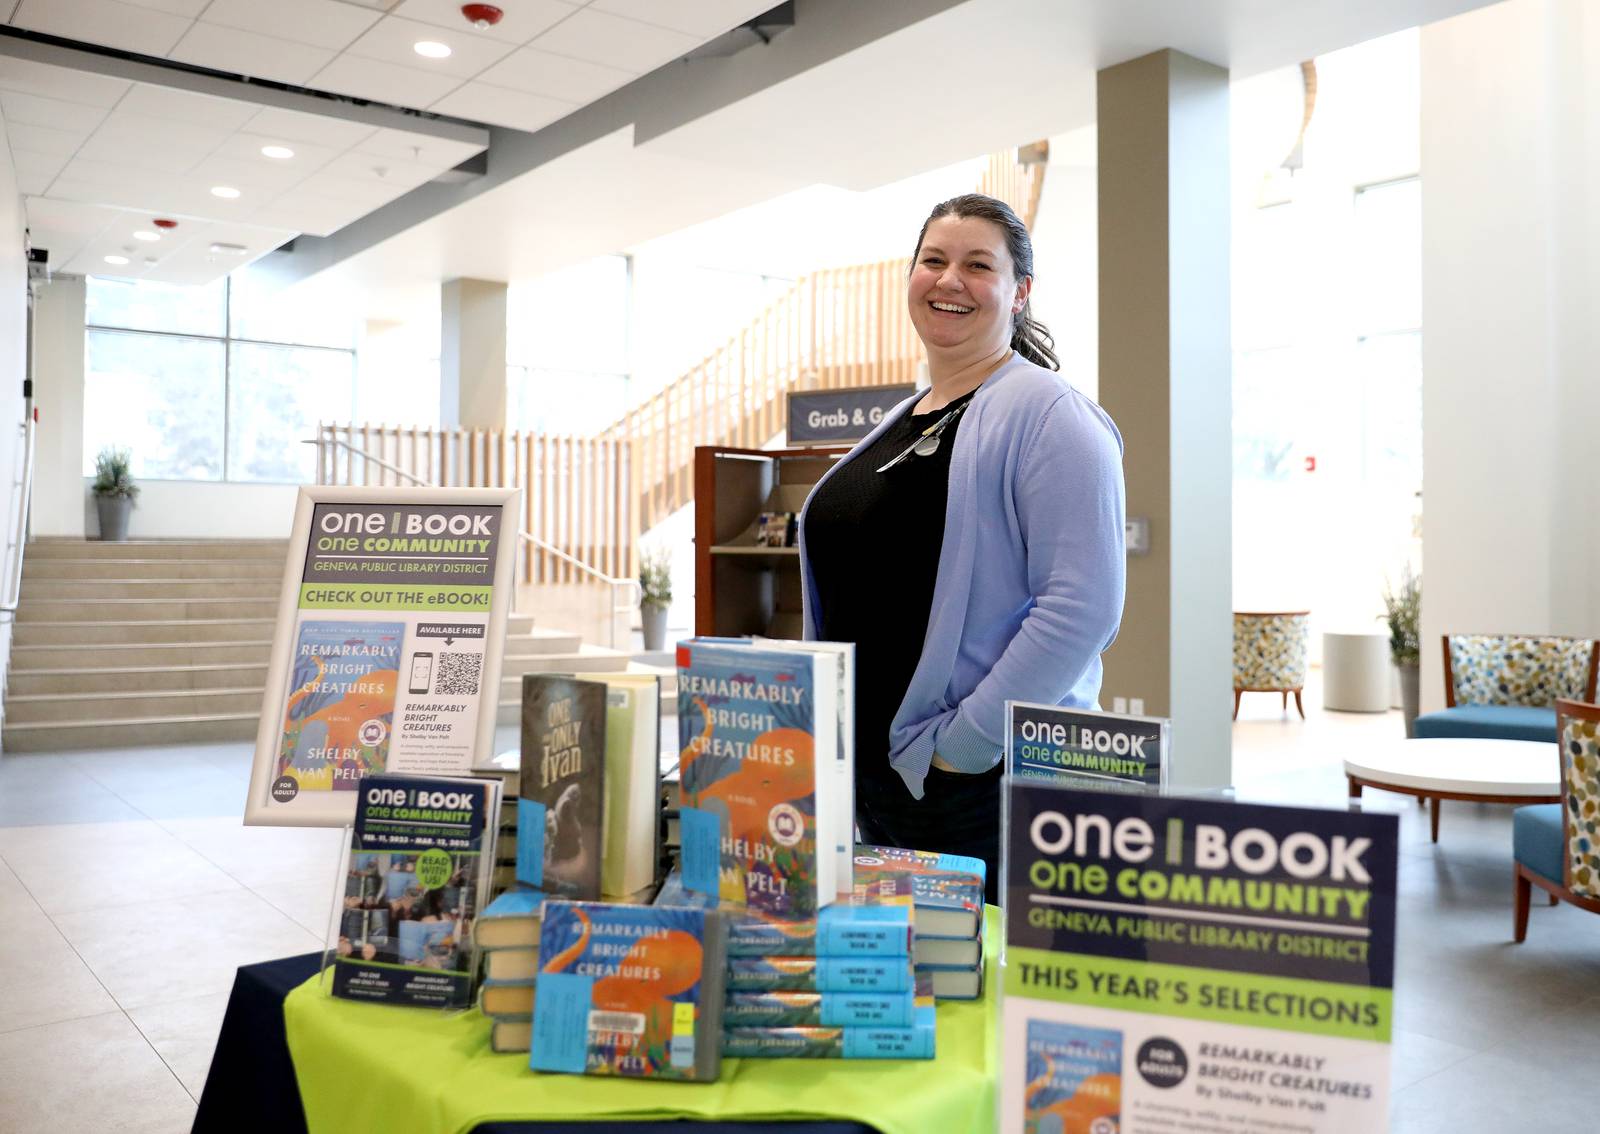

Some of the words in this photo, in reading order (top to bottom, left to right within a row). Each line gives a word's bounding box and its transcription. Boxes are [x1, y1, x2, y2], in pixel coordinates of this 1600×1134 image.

[808, 407, 849, 428] Grab
[852, 408, 866, 426] &
[321, 512, 386, 534] one
[406, 514, 494, 536] BOOK
[317, 536, 359, 551] one
[363, 537, 491, 554] COMMUNITY
[314, 562, 358, 572] GENEVA
[360, 562, 396, 572] PUBLIC
[399, 563, 440, 573] LIBRARY
[443, 563, 488, 574] DISTRICT
[306, 590, 356, 603] CHECK
[360, 591, 393, 604] OUT
[397, 591, 425, 604] THE
[427, 593, 489, 605] eBOOK!
[419, 626, 461, 635] AVAILABLE
[462, 627, 482, 635] HERE
[301, 644, 397, 657] REMARKABLY
[320, 663, 373, 675] BRIGHT
[303, 682, 385, 694] CREATURES
[679, 674, 805, 705] REMARKABLY
[405, 703, 467, 712] REMARKABLY
[404, 714, 438, 722] BRIGHT
[708, 707, 775, 733] BRIGHT
[402, 723, 453, 732] CREATURES
[1021, 720, 1067, 746] one
[1081, 728, 1146, 759] BOOK
[307, 748, 361, 760] SHELBY
[689, 736, 796, 766] CREATURES
[541, 745, 582, 789] Ivan
[1021, 745, 1050, 762] one
[1053, 750, 1146, 777] COMMUNITY
[297, 767, 327, 780] VAN
[334, 768, 365, 780] PELT
[367, 788, 407, 806] one
[417, 791, 474, 810] BOOK
[366, 806, 391, 818] one
[392, 808, 473, 822] COMMUNITY
[721, 837, 777, 863] HELBY
[1030, 810, 1155, 863] one
[1195, 823, 1373, 884] BOOK
[422, 857, 448, 866] READ
[422, 866, 448, 876] WITH
[747, 872, 788, 895] PELT
[1029, 860, 1108, 895] one
[1116, 868, 1371, 921] COMMUNITY
[572, 922, 671, 939] REMARKABLY
[1028, 908, 1113, 935] GENEVA
[1117, 914, 1184, 941] PUBLIC
[1189, 920, 1273, 951] LIBRARY
[1278, 931, 1371, 962] DISTRICT
[592, 943, 648, 958] BRIGHT
[576, 963, 662, 980] CREATURES
[1018, 963, 1080, 991] THIS
[1088, 970, 1190, 1005] YEAR'S
[1198, 984, 1381, 1028] SELECTIONS
[615, 1055, 648, 1070] PELT
[1149, 1048, 1176, 1060] FOR
[1199, 1042, 1326, 1072] REMARKABLY
[1198, 1063, 1266, 1084] BRIGHT
[1269, 1075, 1373, 1100] CREATURES
[1218, 1087, 1263, 1107] Shelby
